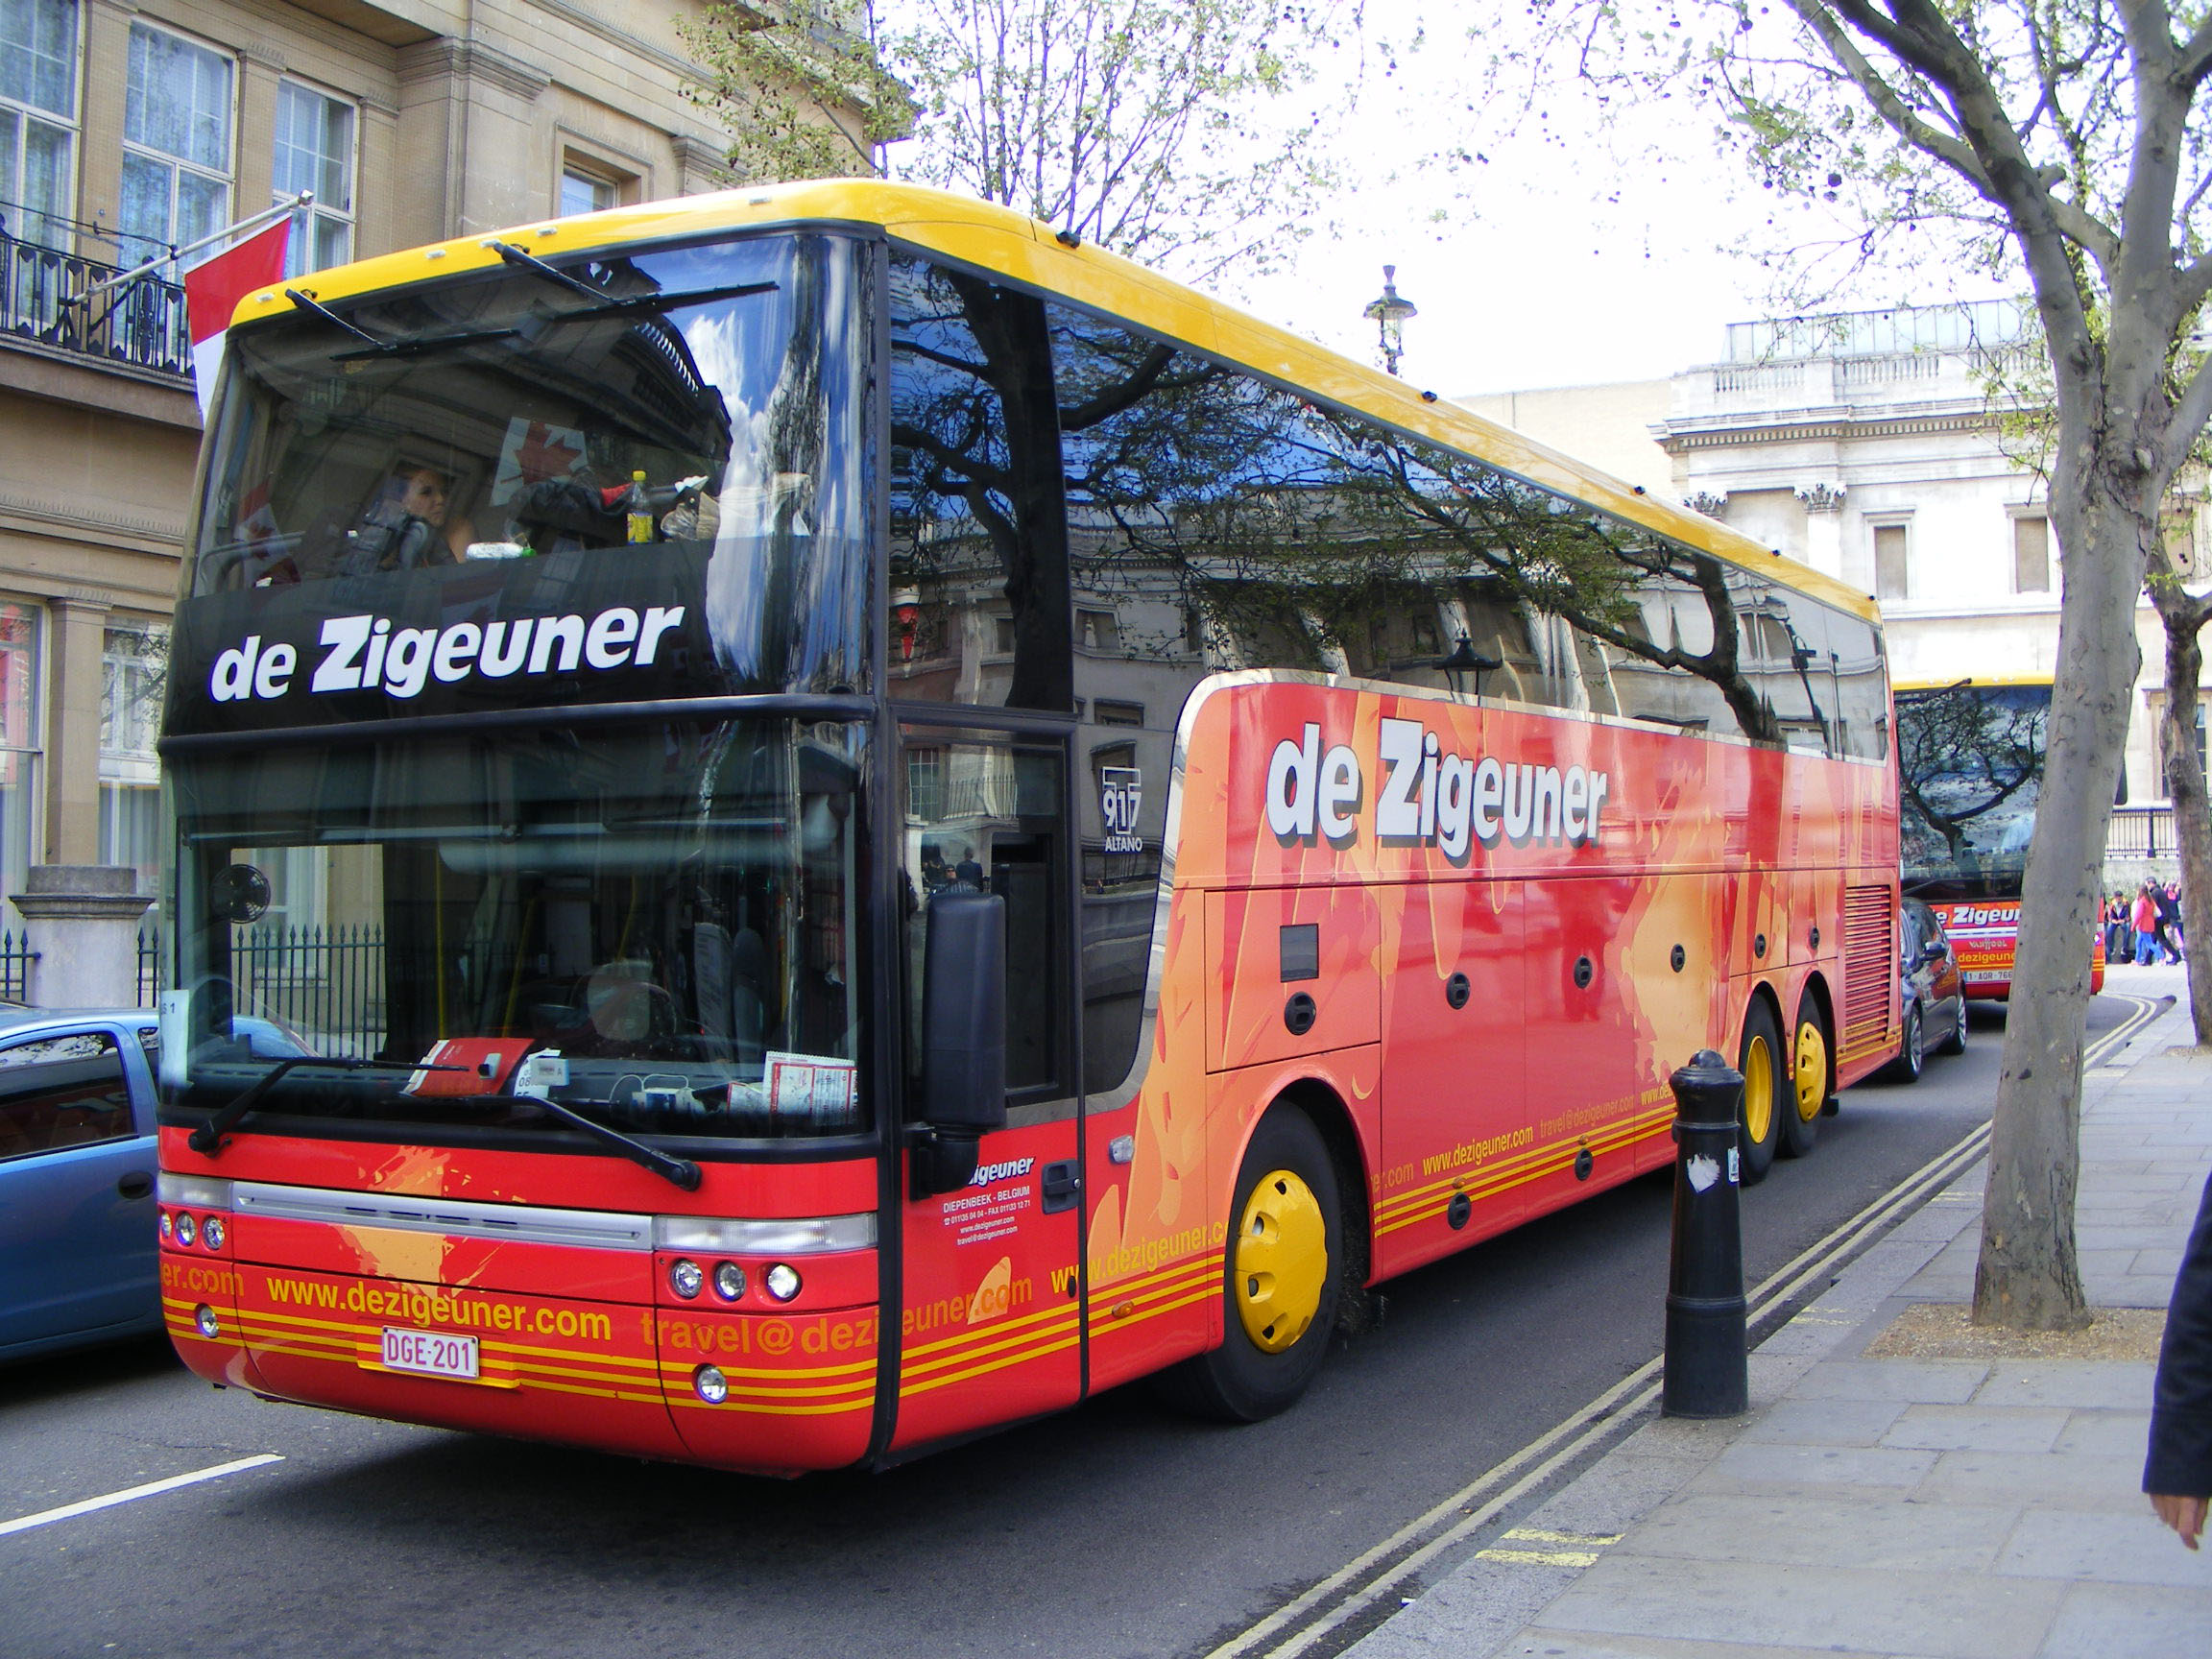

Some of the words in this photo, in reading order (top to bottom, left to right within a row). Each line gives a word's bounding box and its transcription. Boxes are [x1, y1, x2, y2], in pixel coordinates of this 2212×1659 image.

[210, 635, 298, 703] de
[310, 605, 686, 699] Zigeuner
[1266, 722, 1362, 845] de
[1376, 717, 1609, 861] Zigeuner
[1102, 789, 1142, 828] 917
[1105, 836, 1142, 853] ALTANO
[1935, 911, 1948, 925] e
[1540, 1092, 1635, 1139] travel@dezigeuner.com
[1422, 1123, 1534, 1177] www.dezigeuner.com
[968, 1157, 1035, 1187] igeuner
[943, 1193, 992, 1214] DIEPENBEEK
[997, 1185, 1030, 1201] BELGIUM
[987, 1206, 999, 1216] FAX
[266, 1276, 612, 1341] www.dezigeuner.com
[387, 1333, 469, 1371] DGE-201
